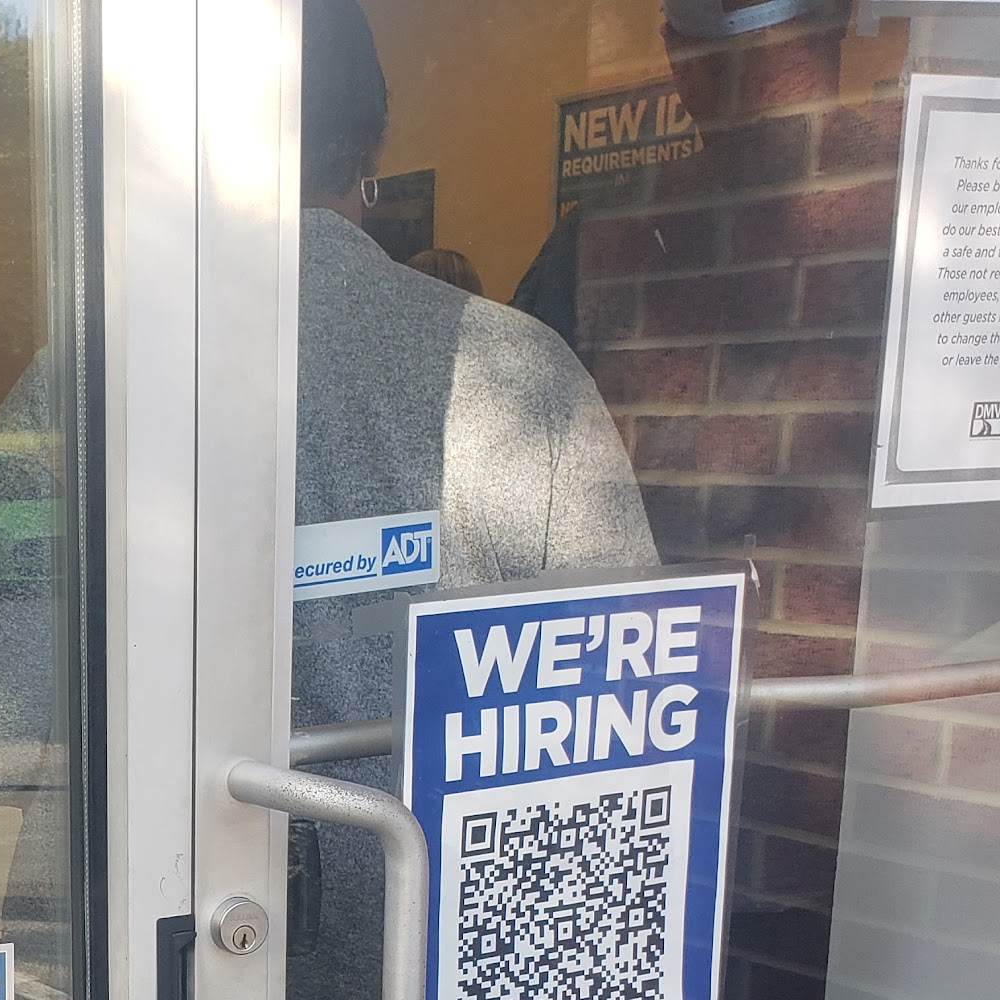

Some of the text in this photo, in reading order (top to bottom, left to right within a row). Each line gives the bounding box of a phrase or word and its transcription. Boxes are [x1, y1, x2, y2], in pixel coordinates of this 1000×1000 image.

[564, 92, 693, 153] NEW ID
[562, 139, 692, 177] REQUIREMENTS
[954, 156, 989, 170] Thanks
[956, 179, 990, 192] Please
[951, 203, 968, 214] our
[942, 223, 956, 235] do
[958, 226, 976, 236] our
[942, 248, 949, 257] a
[951, 245, 972, 258] safe
[974, 245, 996, 258] and
[938, 267, 967, 280] Those
[968, 268, 988, 280] not
[943, 289, 999, 304] employees,
[932, 311, 961, 323] other
[962, 311, 996, 326] guests
[937, 333, 948, 345] to
[951, 332, 988, 346] change
[942, 353, 999, 366] or leave the
[974, 403, 1000, 420] DMV
[382, 530, 432, 568] ADT
[294, 554, 377, 579] ecured by
[445, 684, 699, 783] HIRING
